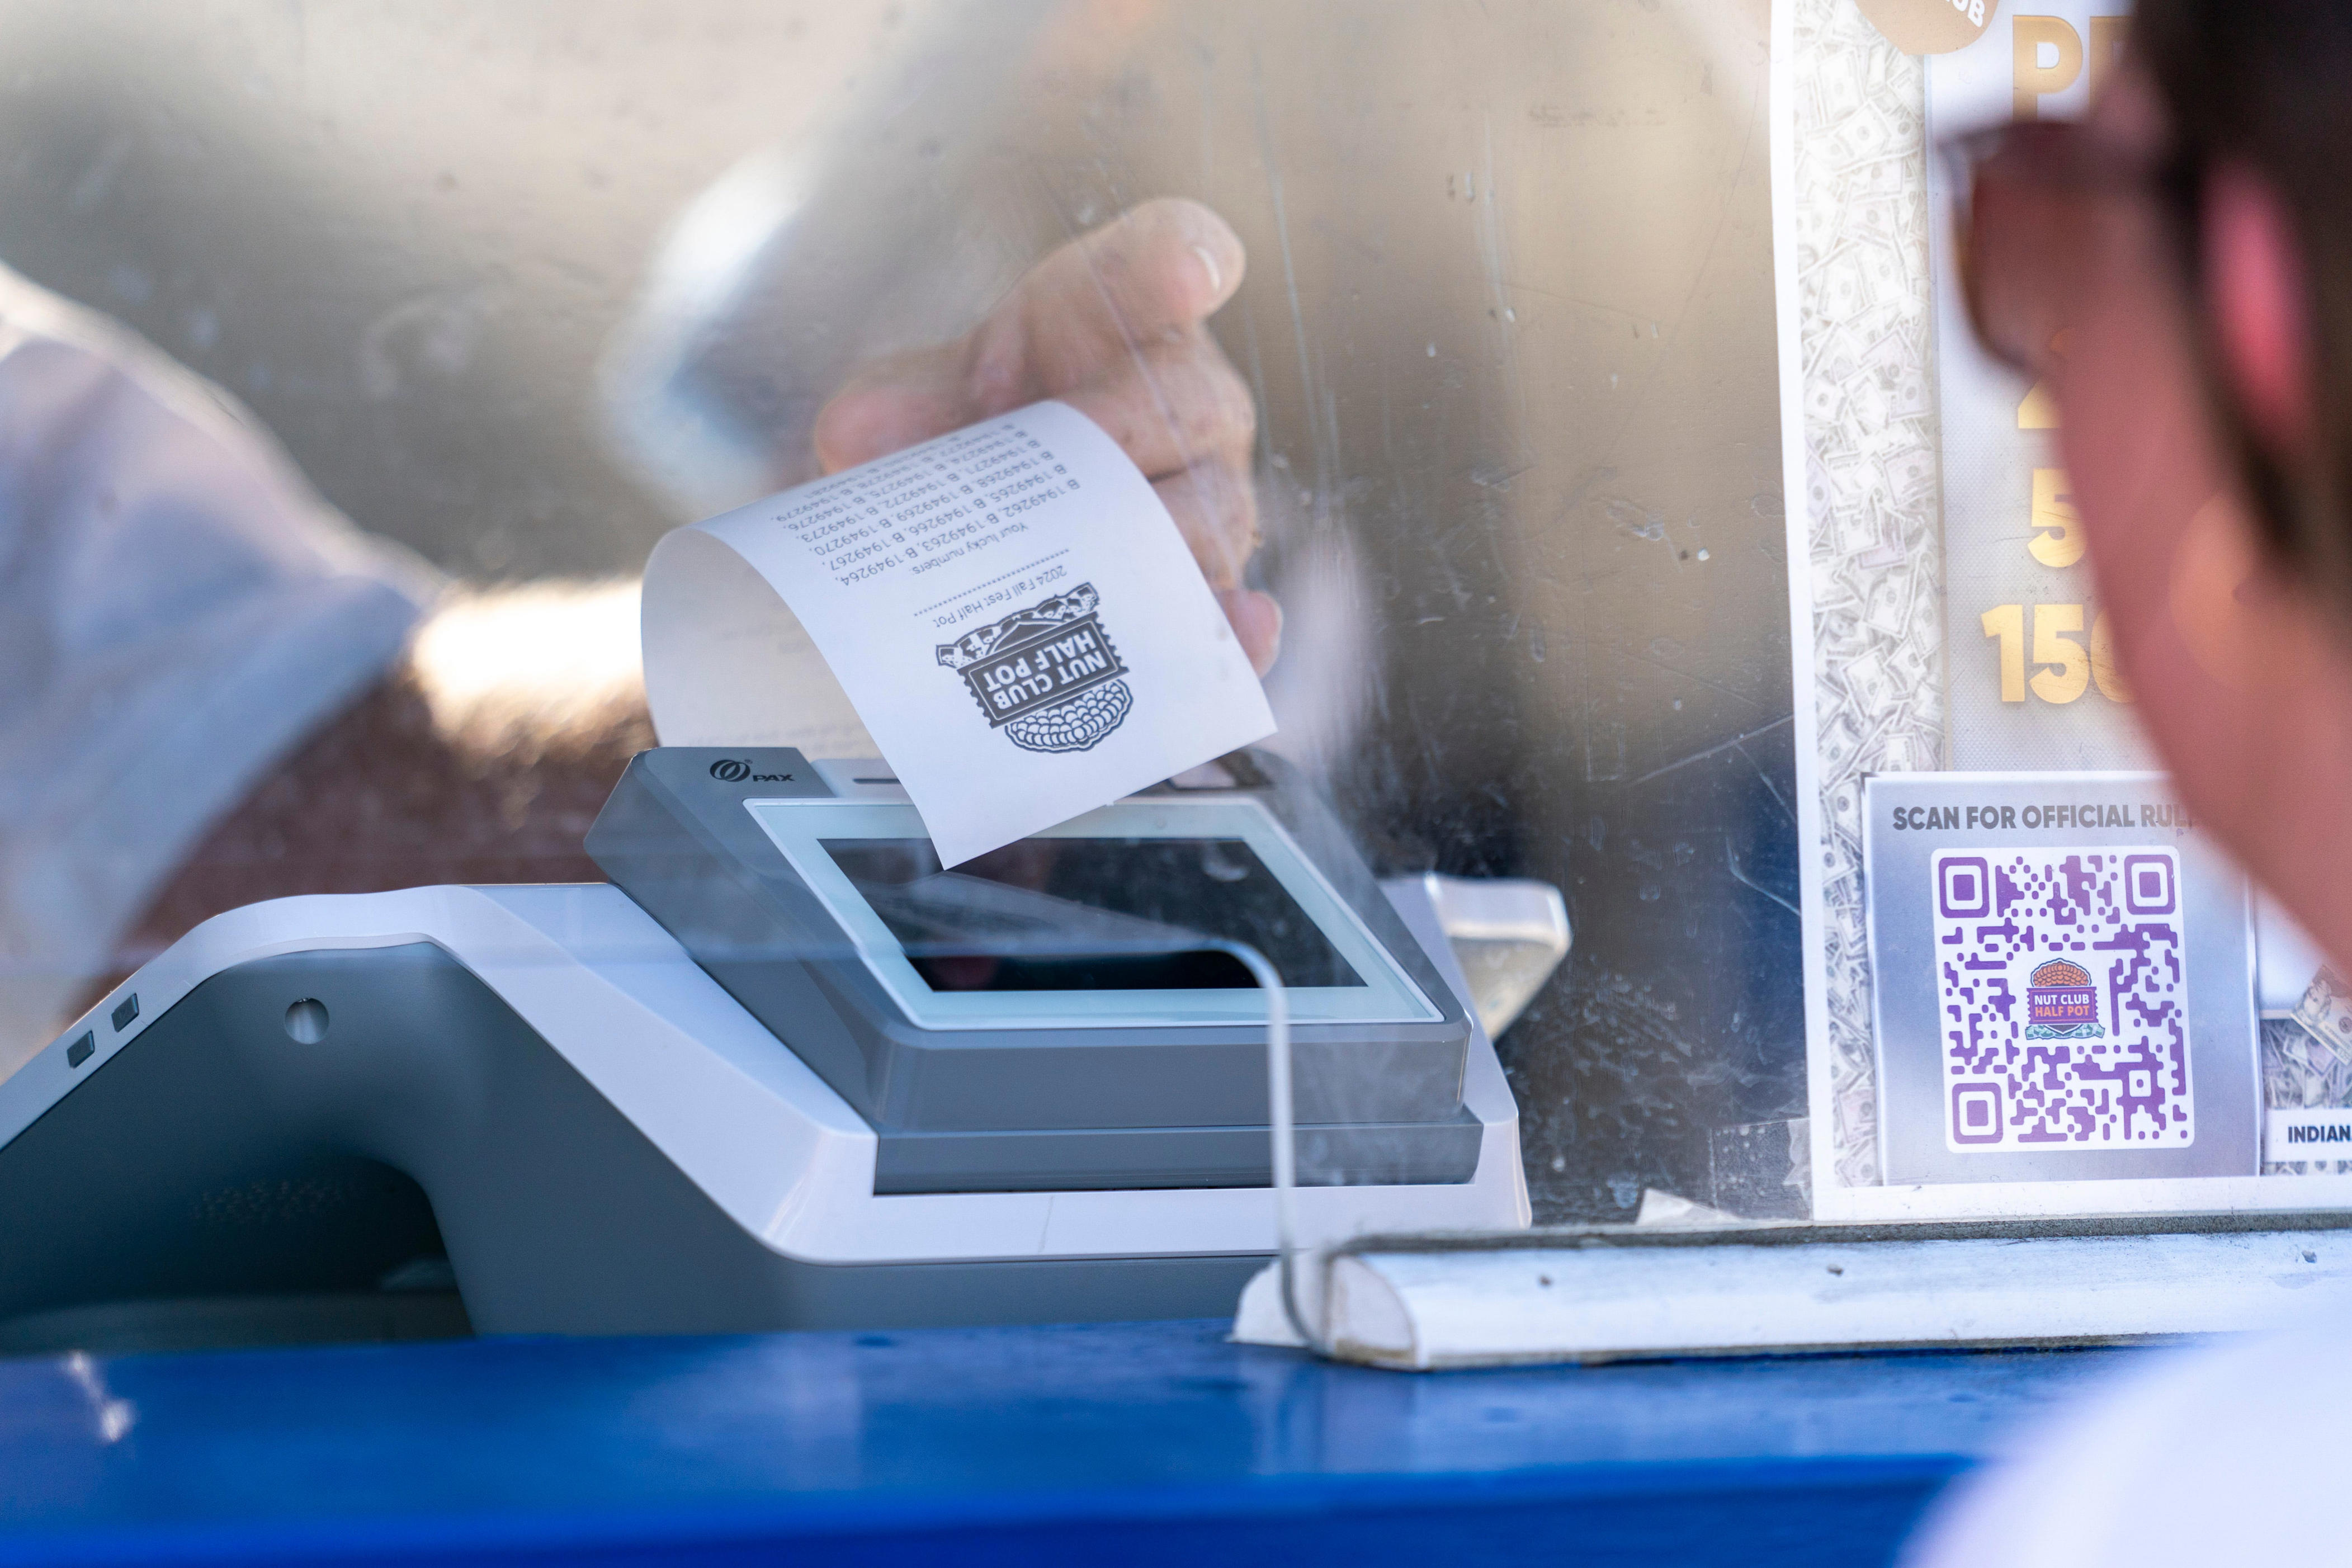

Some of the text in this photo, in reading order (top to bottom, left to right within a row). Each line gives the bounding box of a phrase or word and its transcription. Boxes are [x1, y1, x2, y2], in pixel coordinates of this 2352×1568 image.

[966, 531, 1002, 554] lucky
[1000, 522, 1029, 541] Your
[933, 565, 1068, 628] 2024 Fall Fest Half Pot
[983, 630, 1097, 693] HALF POT
[993, 651, 1108, 710] NUT CLUB
[1892, 806, 1959, 830] SCAN
[1966, 806, 2016, 829] FOR
[2022, 804, 2135, 829] OFFICIAL
[2034, 994, 2090, 1005] NUT CLUB
[2035, 1005, 2090, 1017] HALF POT
